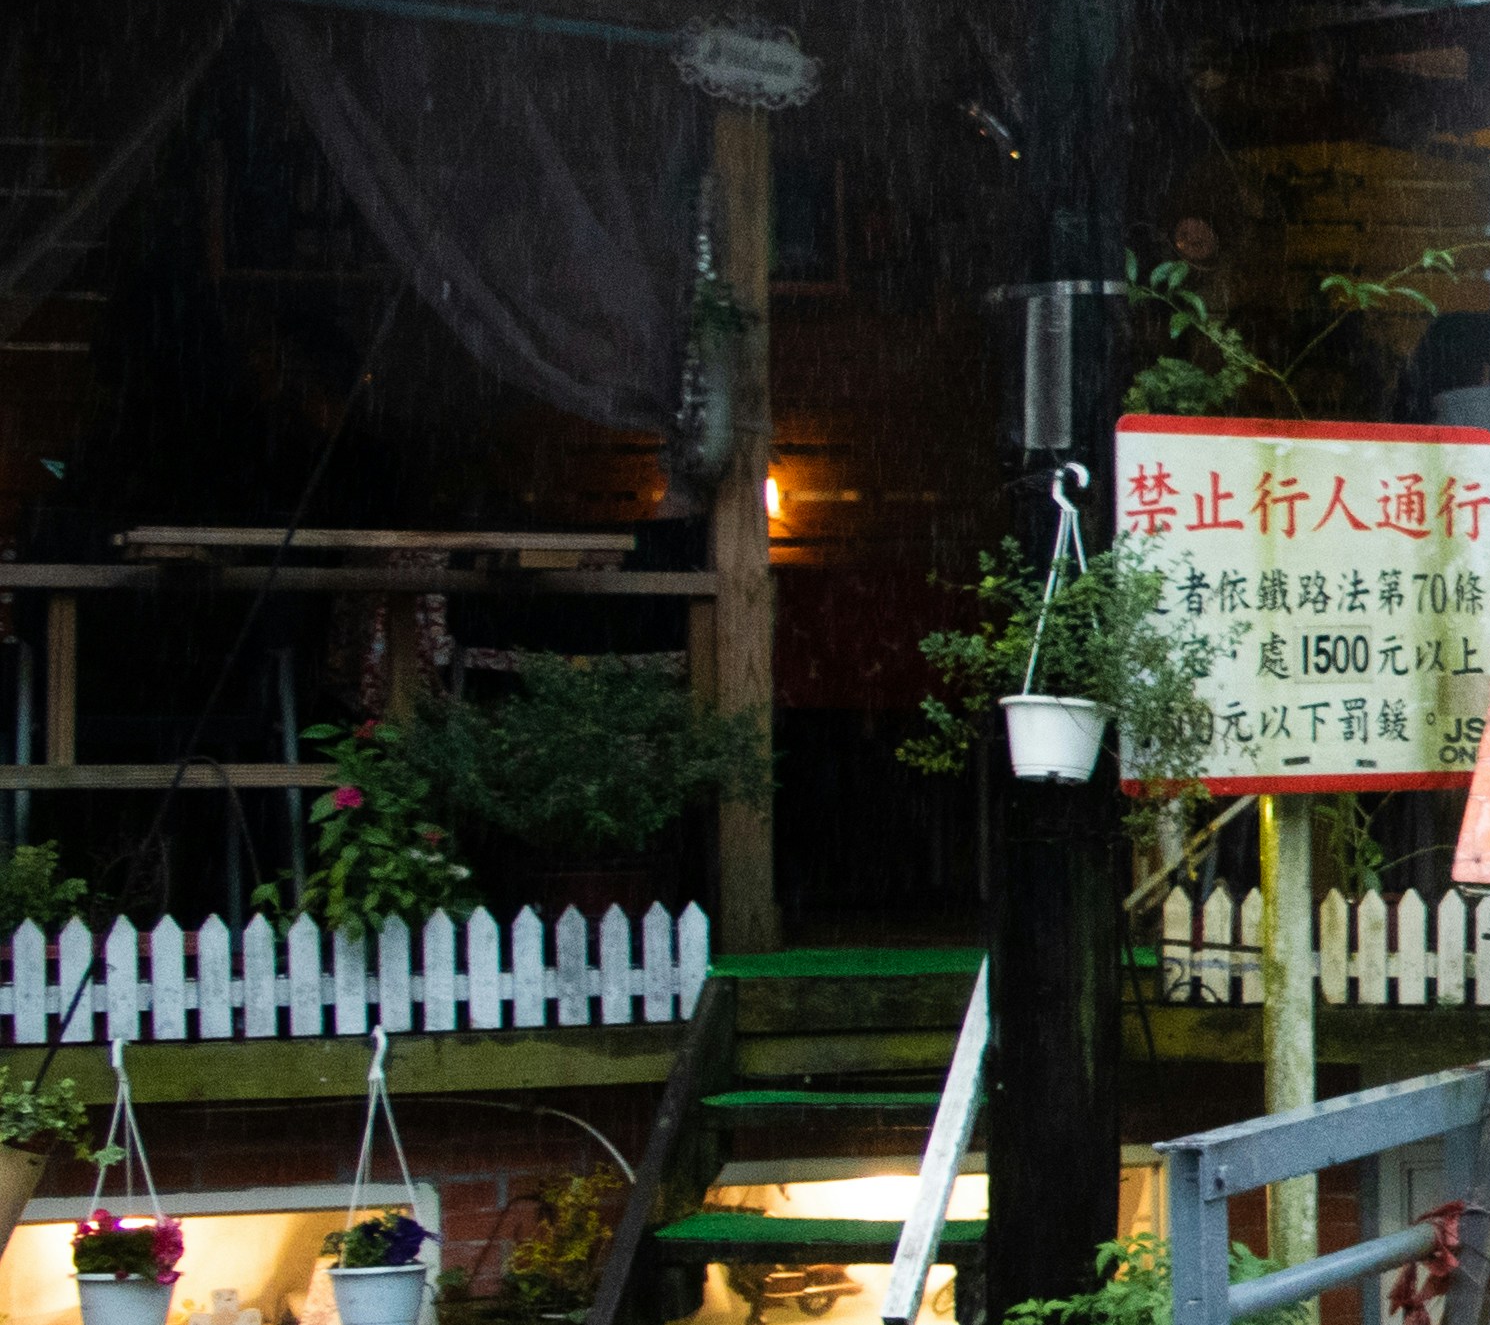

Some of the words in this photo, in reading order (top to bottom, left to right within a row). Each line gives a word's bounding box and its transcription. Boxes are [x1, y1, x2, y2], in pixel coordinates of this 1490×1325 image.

[1140, 568, 1486, 617] 者依鐵路法第70條
